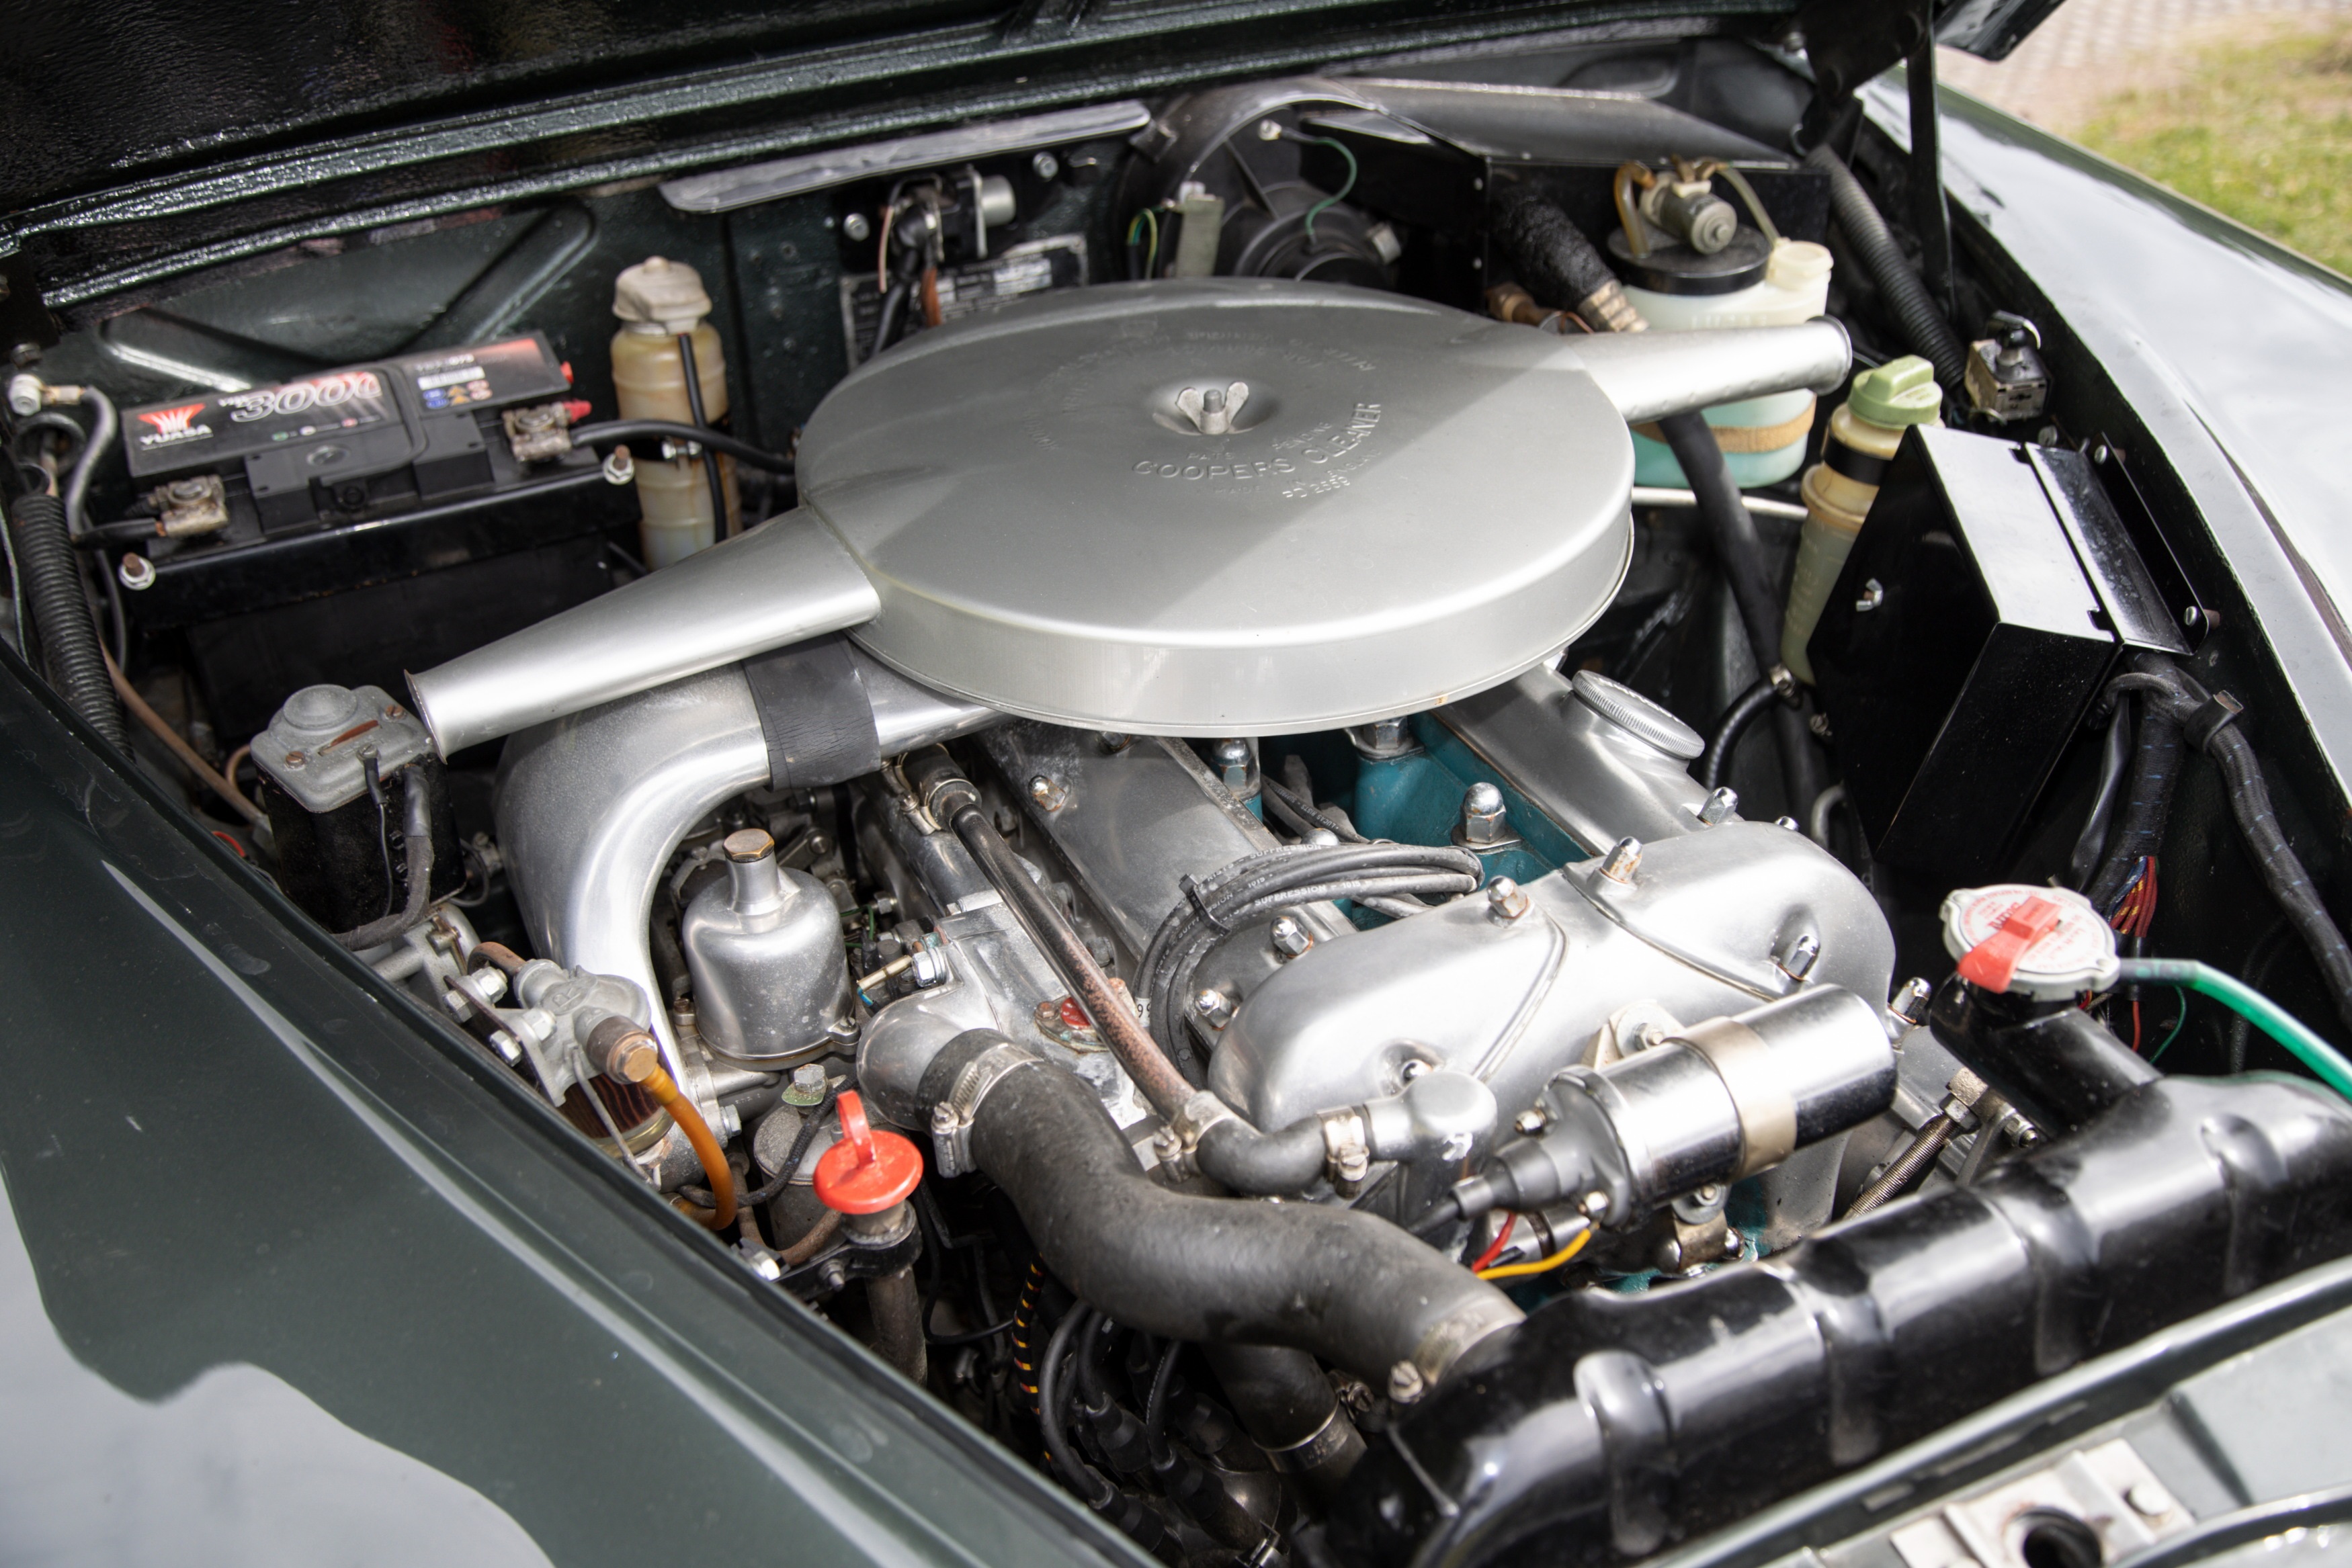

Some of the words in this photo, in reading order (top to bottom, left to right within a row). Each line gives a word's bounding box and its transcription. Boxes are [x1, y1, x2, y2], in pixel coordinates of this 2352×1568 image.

[140, 424, 212, 446] YUASA
[1132, 458, 1296, 480] COOPERS
[1300, 402, 1382, 465] CLEANER
[1300, 804, 1317, 816] RISTS
[1316, 814, 1337, 828] LUCAS
[1249, 842, 1322, 860] SUPPRESSION
[1254, 884, 1327, 907] SUPPRESSION
